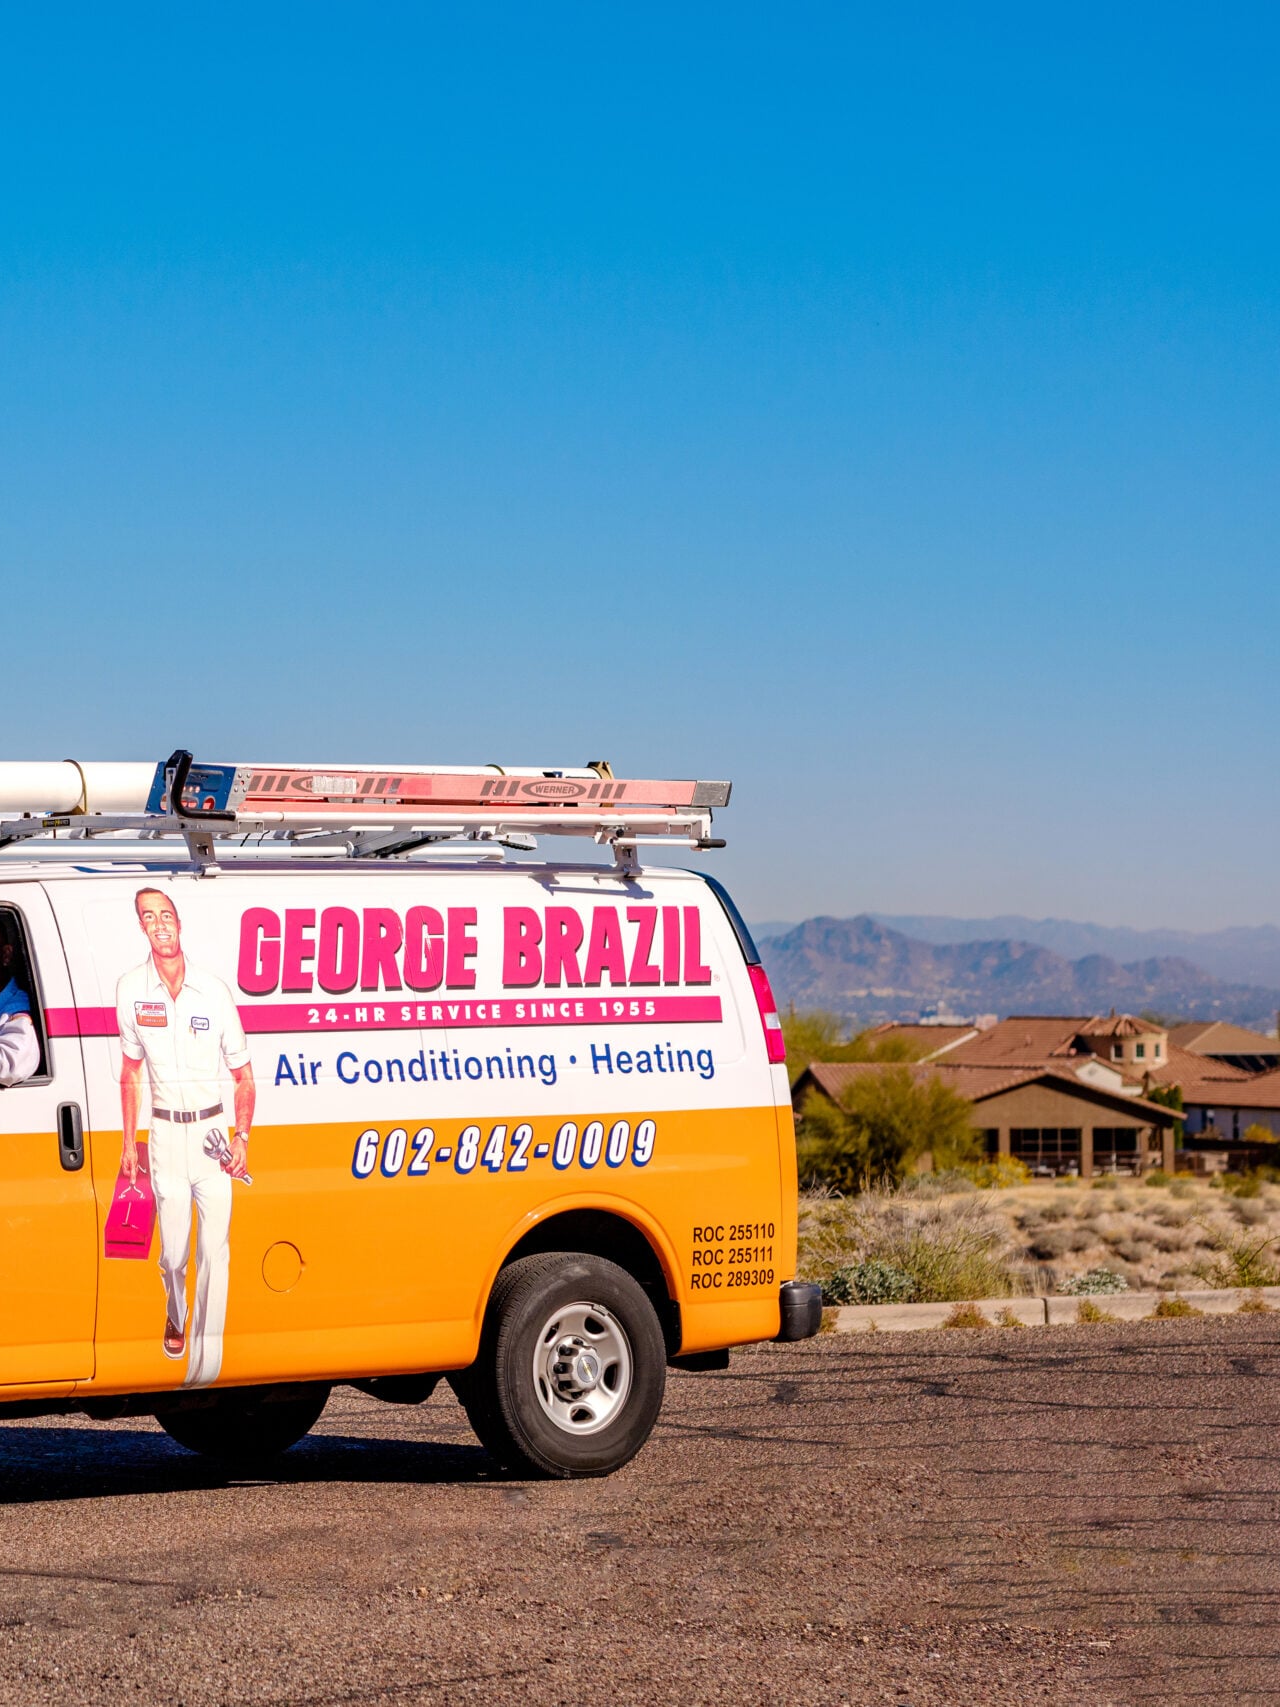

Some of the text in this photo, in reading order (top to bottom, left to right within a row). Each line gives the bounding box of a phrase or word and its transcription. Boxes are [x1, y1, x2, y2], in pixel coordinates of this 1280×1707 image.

[535, 785, 575, 794] WERNER
[237, 905, 712, 997] GEORGE BRAZIL
[307, 1001, 656, 1024] 24-HR SERVICE SINCE 1955
[274, 1042, 715, 1086] Air Conditioning Heating
[351, 1118, 657, 1179] 602-842-0009
[693, 1222, 775, 1243] ROC 255110
[692, 1245, 773, 1267] ROC 255111
[690, 1269, 775, 1290] ROC 289309
